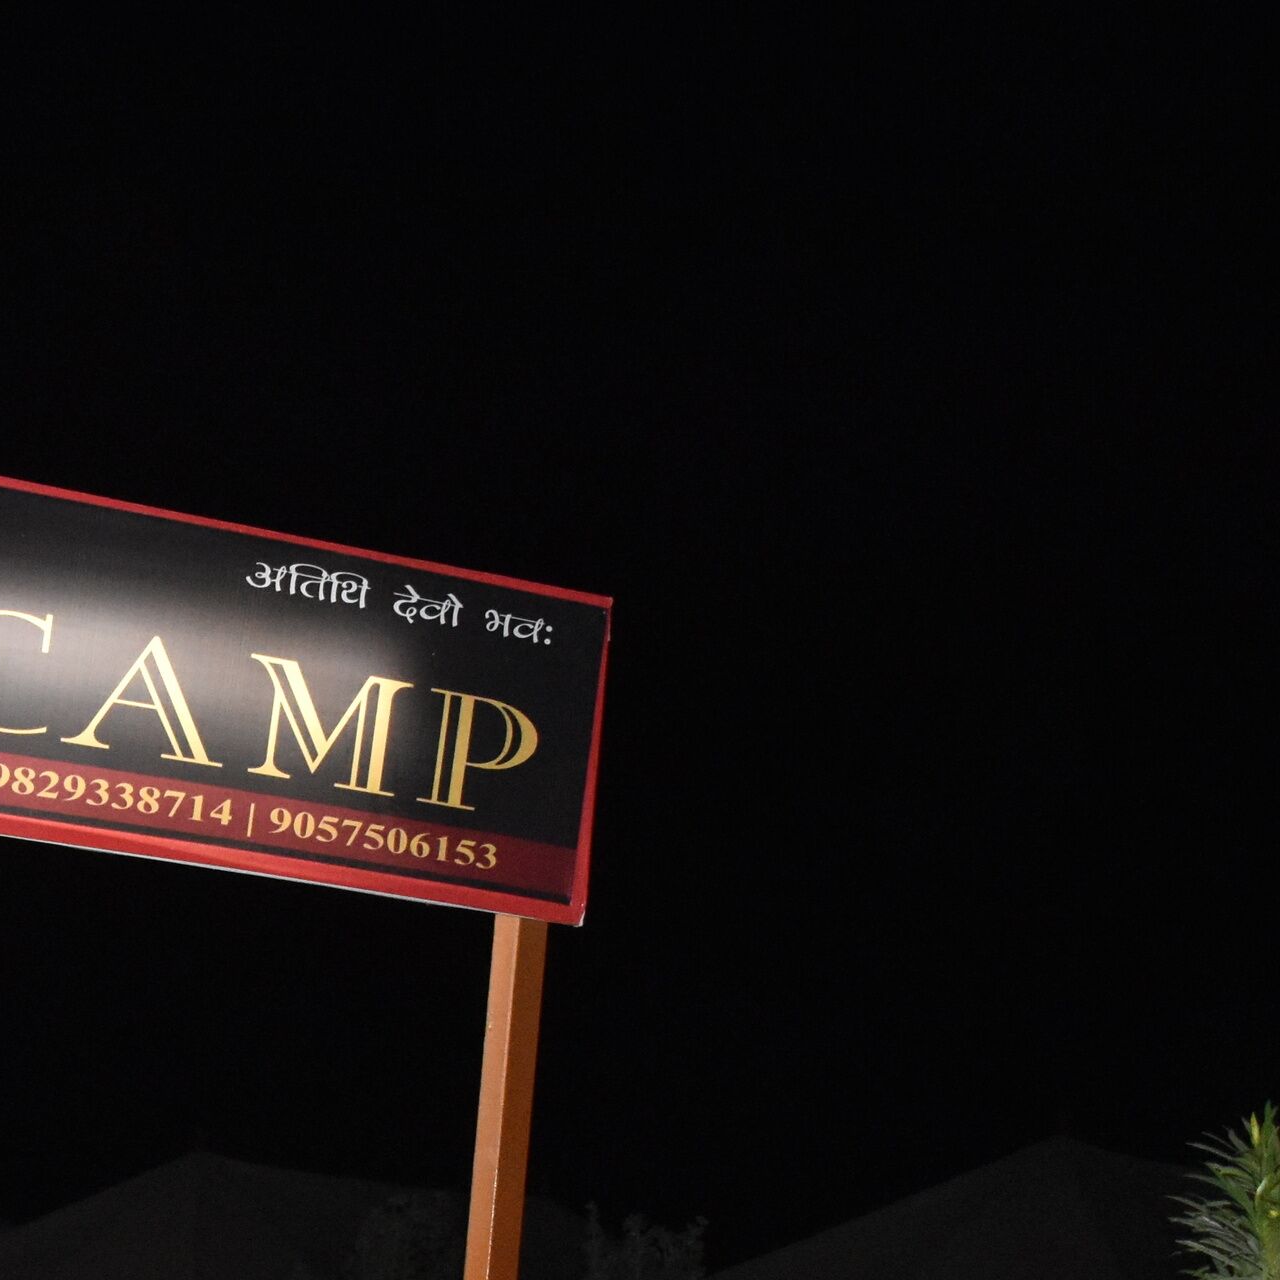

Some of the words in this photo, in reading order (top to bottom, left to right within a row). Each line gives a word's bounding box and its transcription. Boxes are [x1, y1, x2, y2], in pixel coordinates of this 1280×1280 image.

[246, 562, 371, 609] अतिथि
[393, 585, 463, 627] देवो
[269, 807, 498, 870] 9057506153
